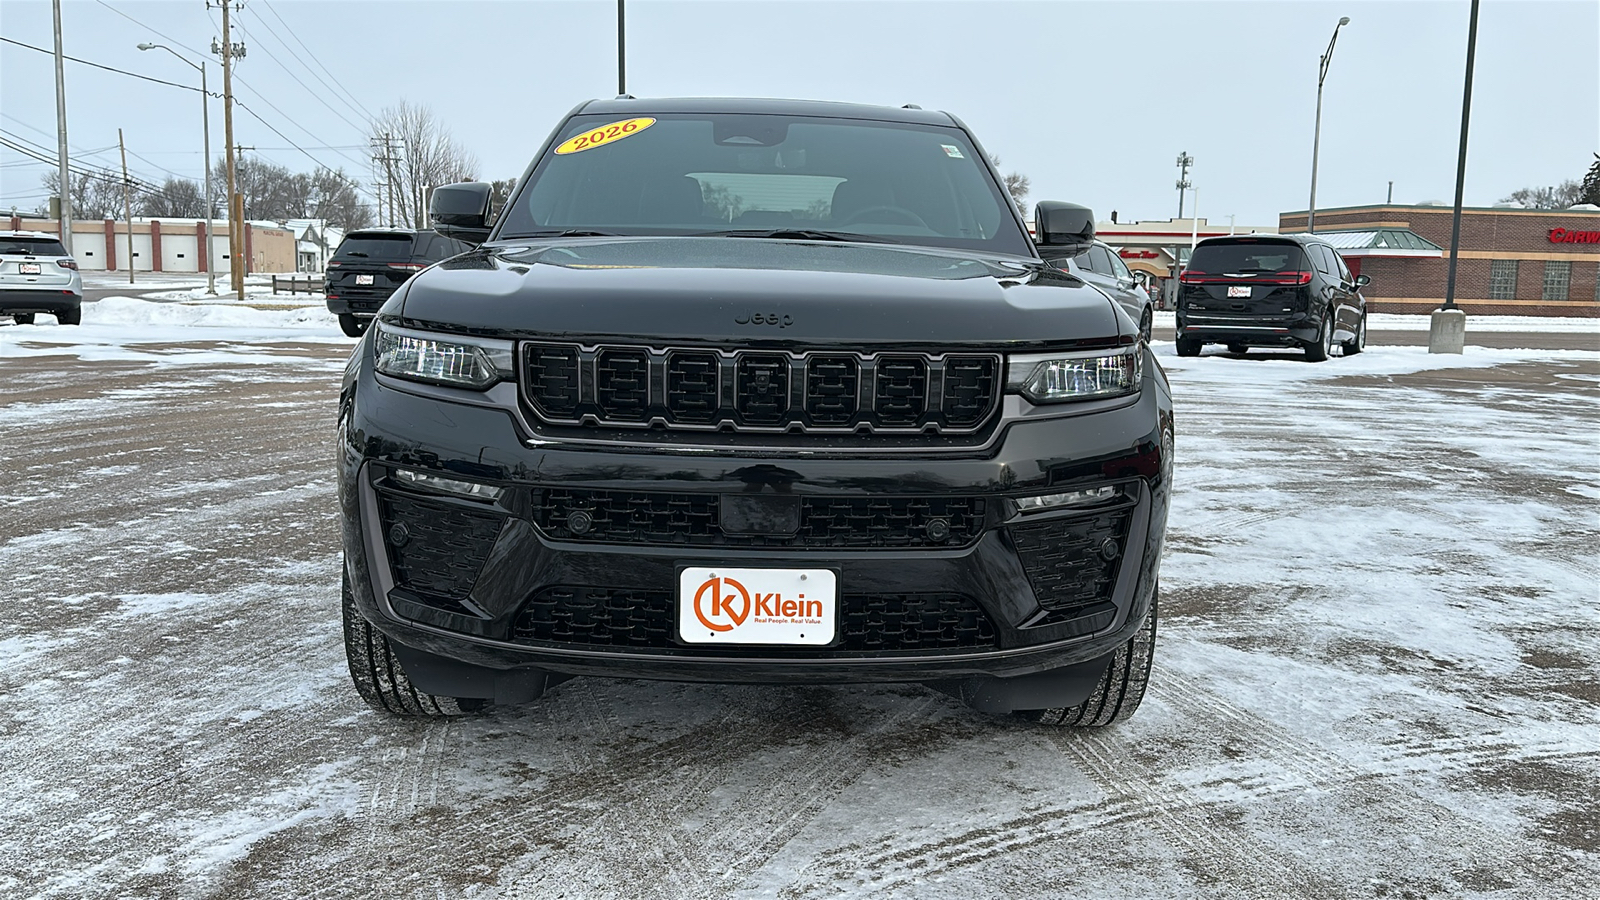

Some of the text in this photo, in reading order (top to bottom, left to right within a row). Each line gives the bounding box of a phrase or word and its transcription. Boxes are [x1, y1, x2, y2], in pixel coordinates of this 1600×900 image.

[573, 119, 638, 151] 2026
[734, 308, 795, 329] Jeep
[754, 593, 823, 618] Klein
[768, 617, 789, 625] People.
